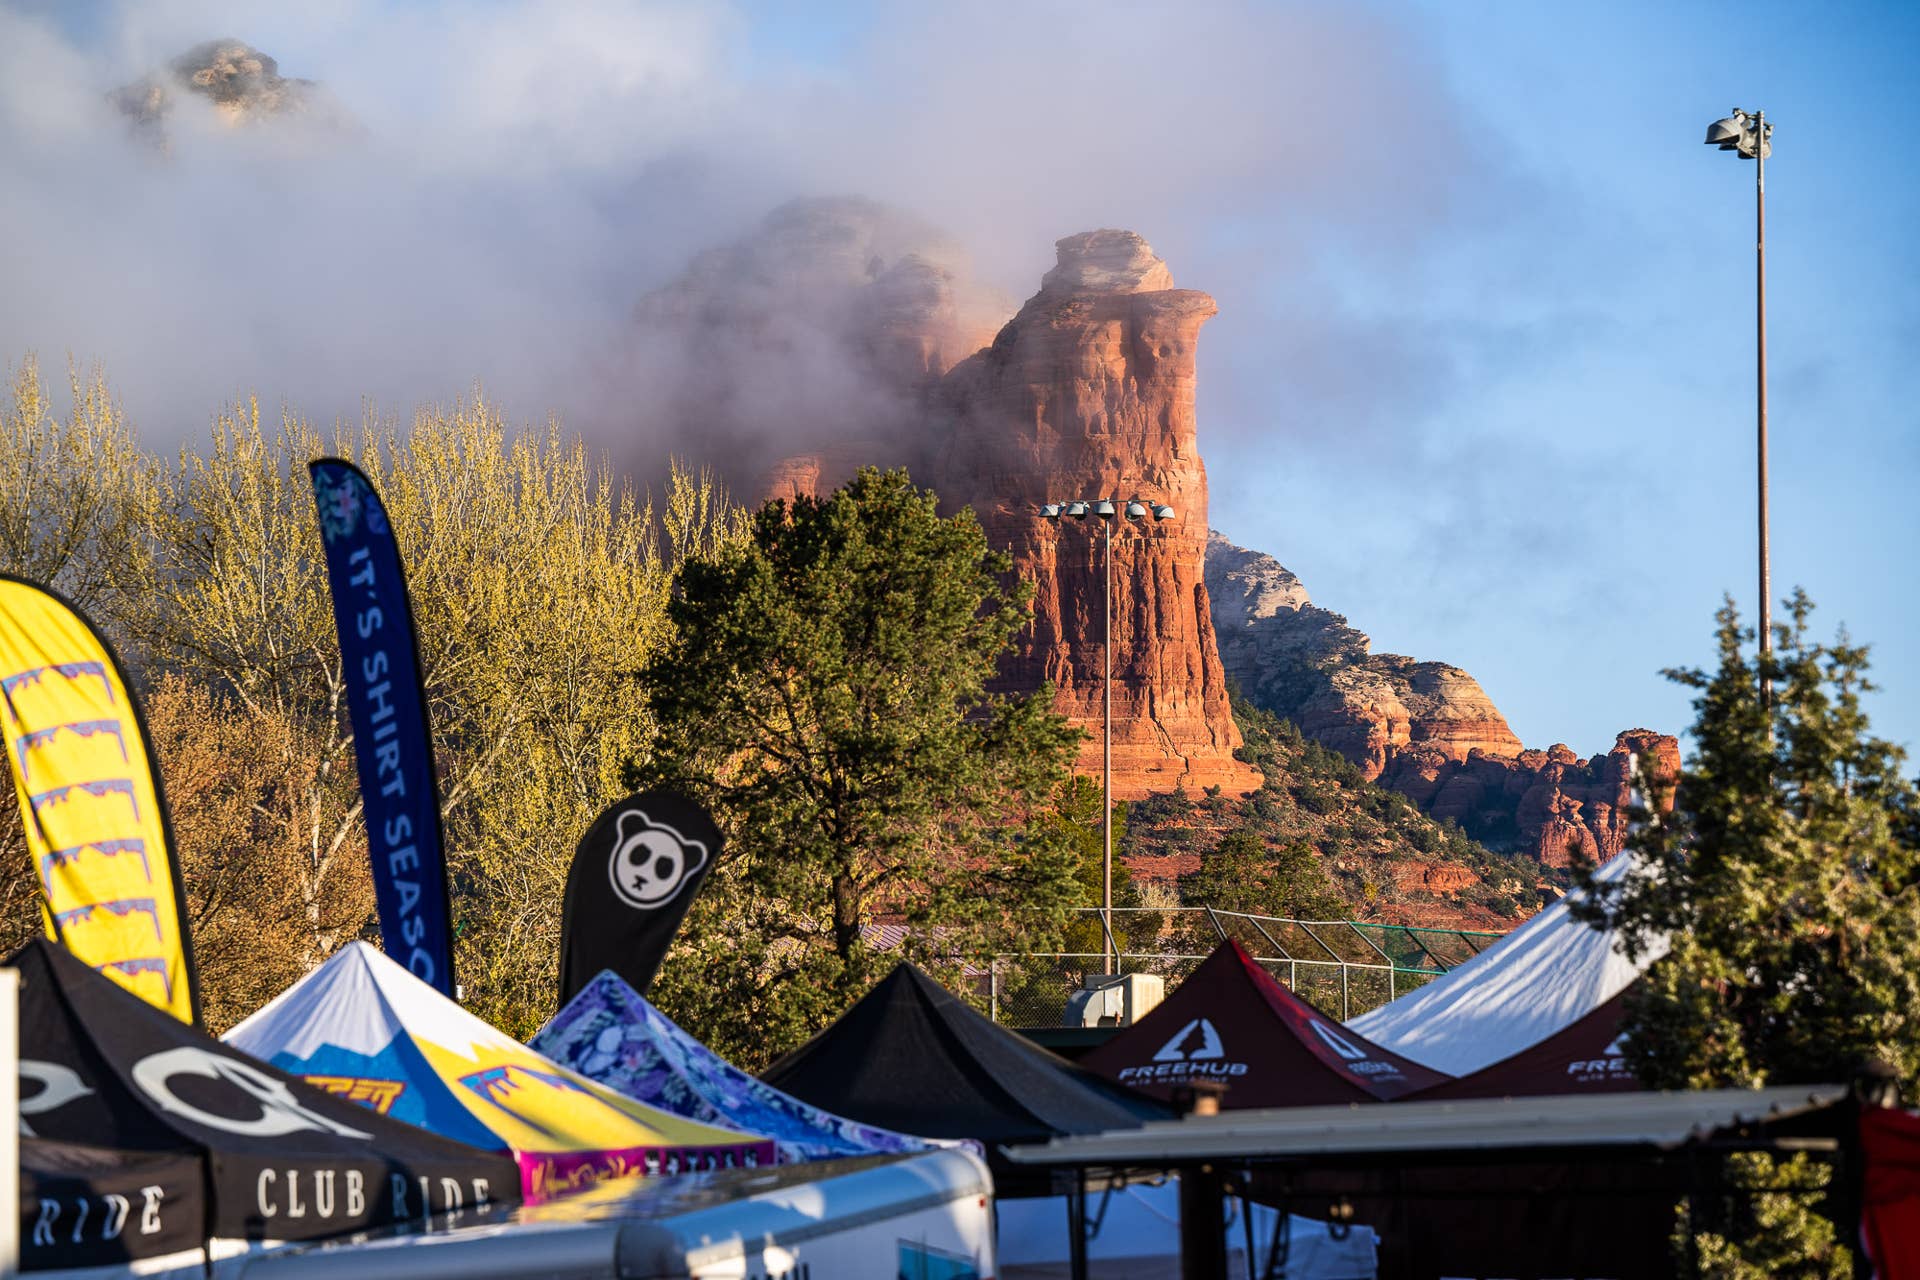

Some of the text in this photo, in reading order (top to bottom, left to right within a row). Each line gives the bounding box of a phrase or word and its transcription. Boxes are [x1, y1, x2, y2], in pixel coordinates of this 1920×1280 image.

[349, 546, 383, 639] IT'S
[363, 651, 406, 797] SHIRT
[1119, 1061, 1248, 1080] FREEHUB
[1567, 1058, 1627, 1074] FRE
[32, 1185, 165, 1247] RIDE
[257, 1168, 366, 1218] CLUB
[389, 1172, 491, 1217] RIDE
